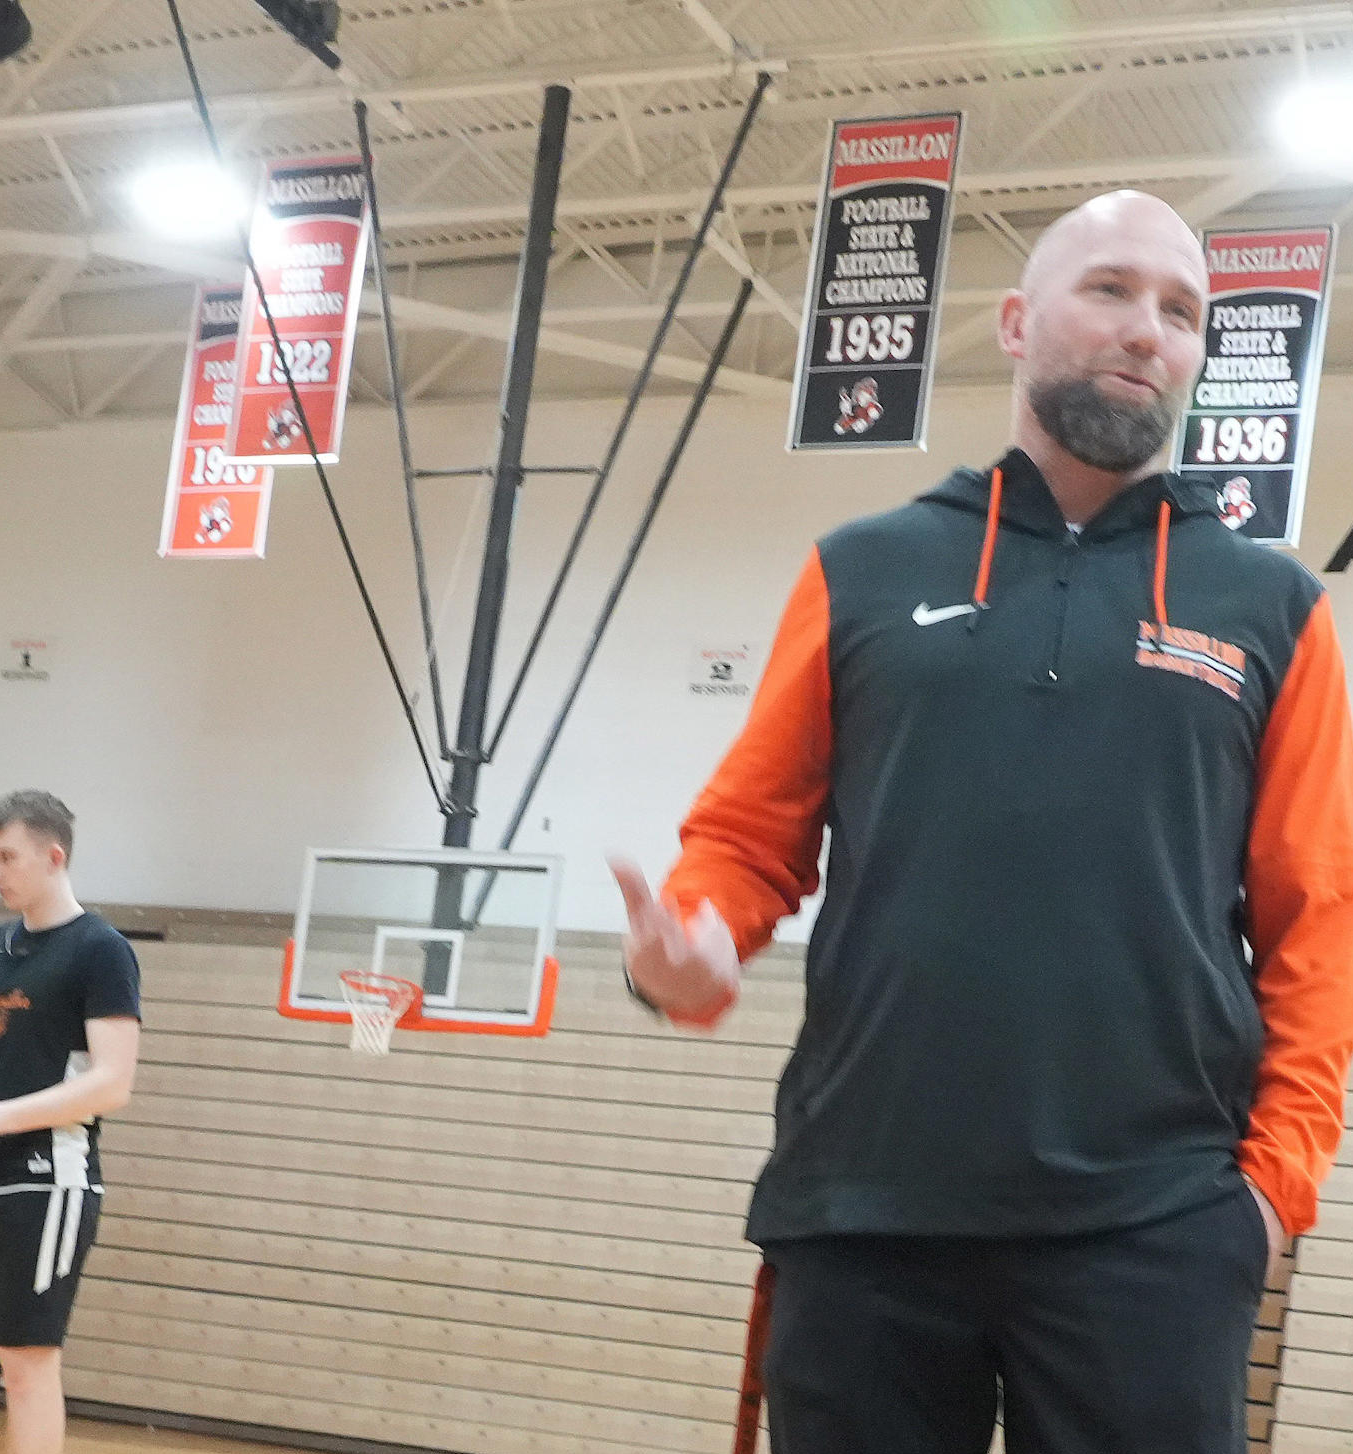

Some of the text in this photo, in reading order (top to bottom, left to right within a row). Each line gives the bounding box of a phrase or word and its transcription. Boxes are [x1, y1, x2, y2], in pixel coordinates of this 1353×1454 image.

[836, 133, 952, 167] MASSILLON
[842, 195, 931, 224] FOOTBALL
[1208, 245, 1324, 273] MASSILLON
[826, 276, 928, 305] CHAMPIONS
[1212, 304, 1302, 330] FOOTBALL
[826, 314, 915, 363] 1935
[256, 340, 332, 385] 1922
[1196, 380, 1299, 408] CHAMPIONS
[1197, 417, 1288, 463] 1936
